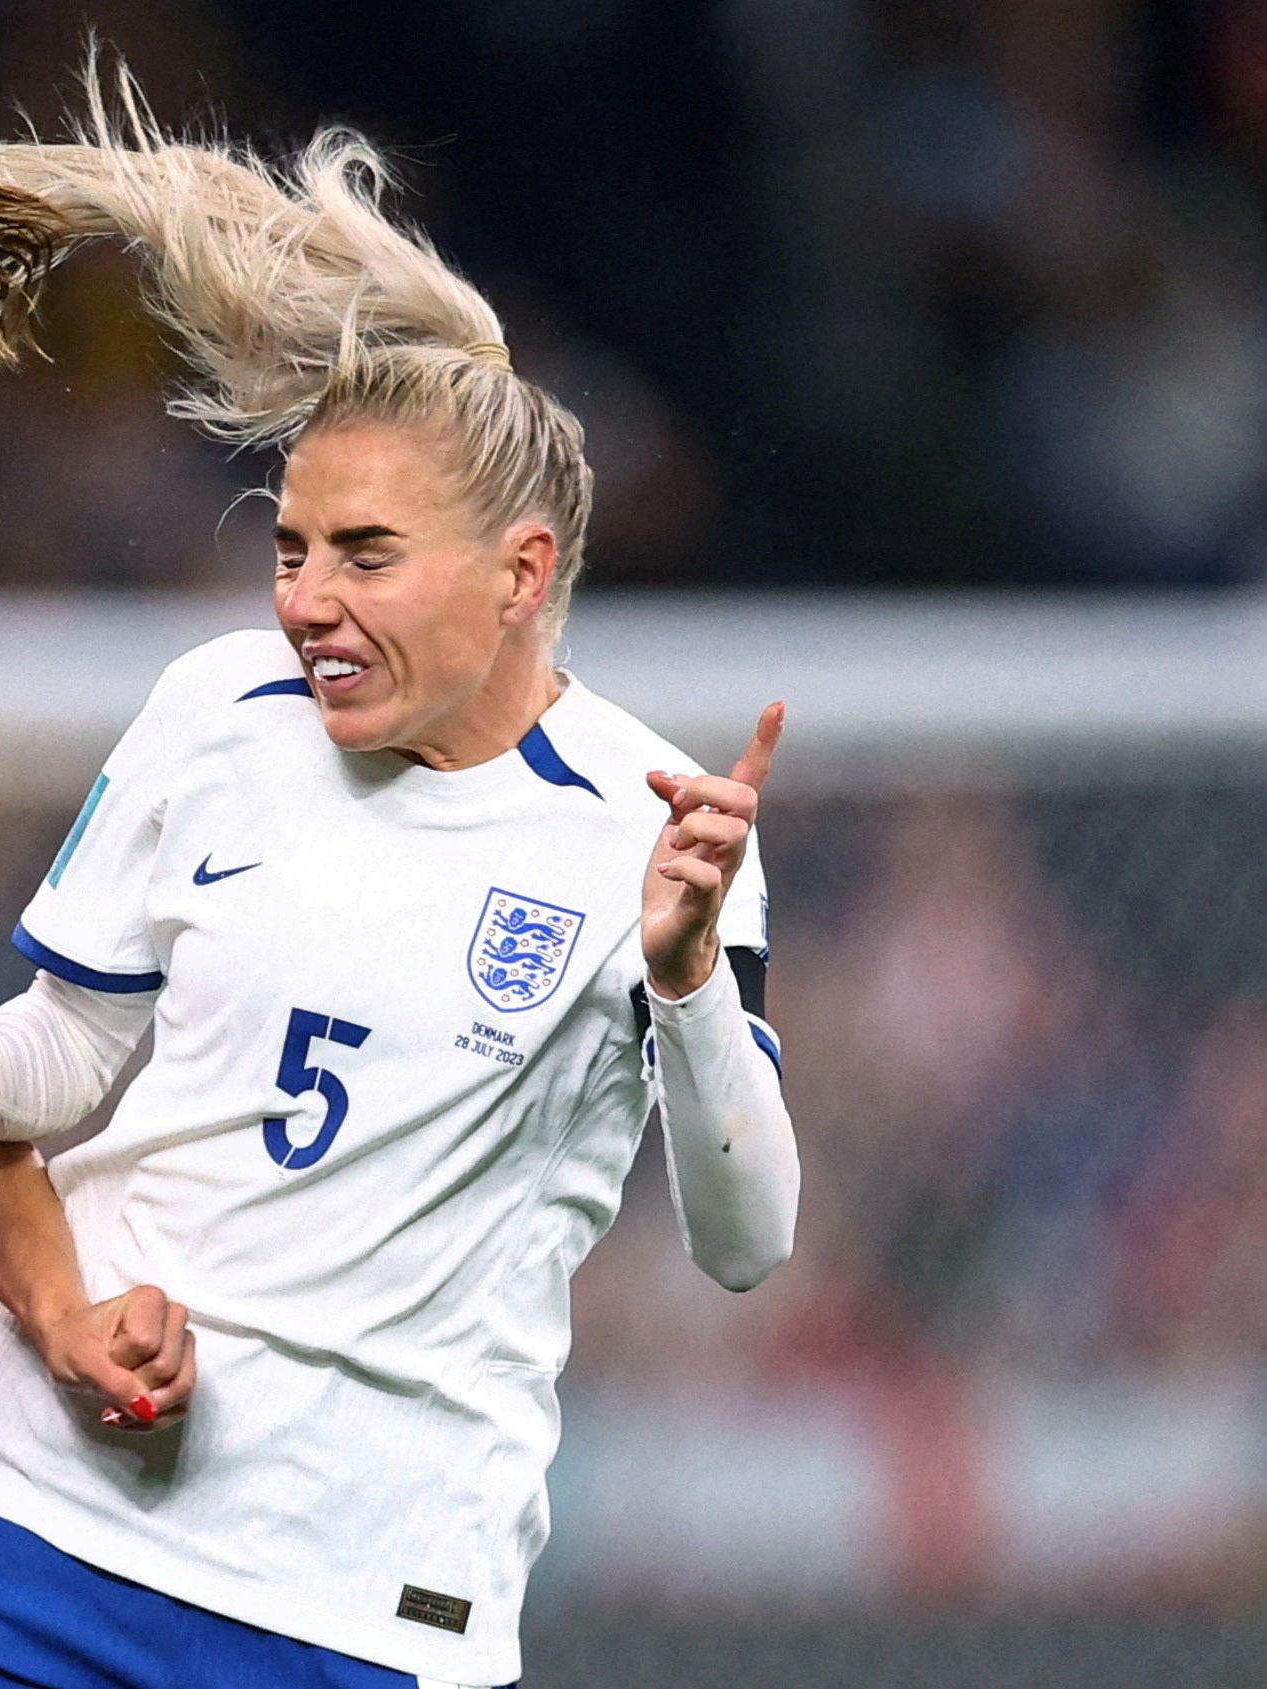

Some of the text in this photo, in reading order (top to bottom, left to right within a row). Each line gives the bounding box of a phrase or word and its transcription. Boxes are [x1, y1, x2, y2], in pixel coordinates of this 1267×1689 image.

[454, 1034, 524, 1066] 28 JULY 2023
[472, 1021, 515, 1047] DENMARK
[263, 1006, 372, 1170] 5
